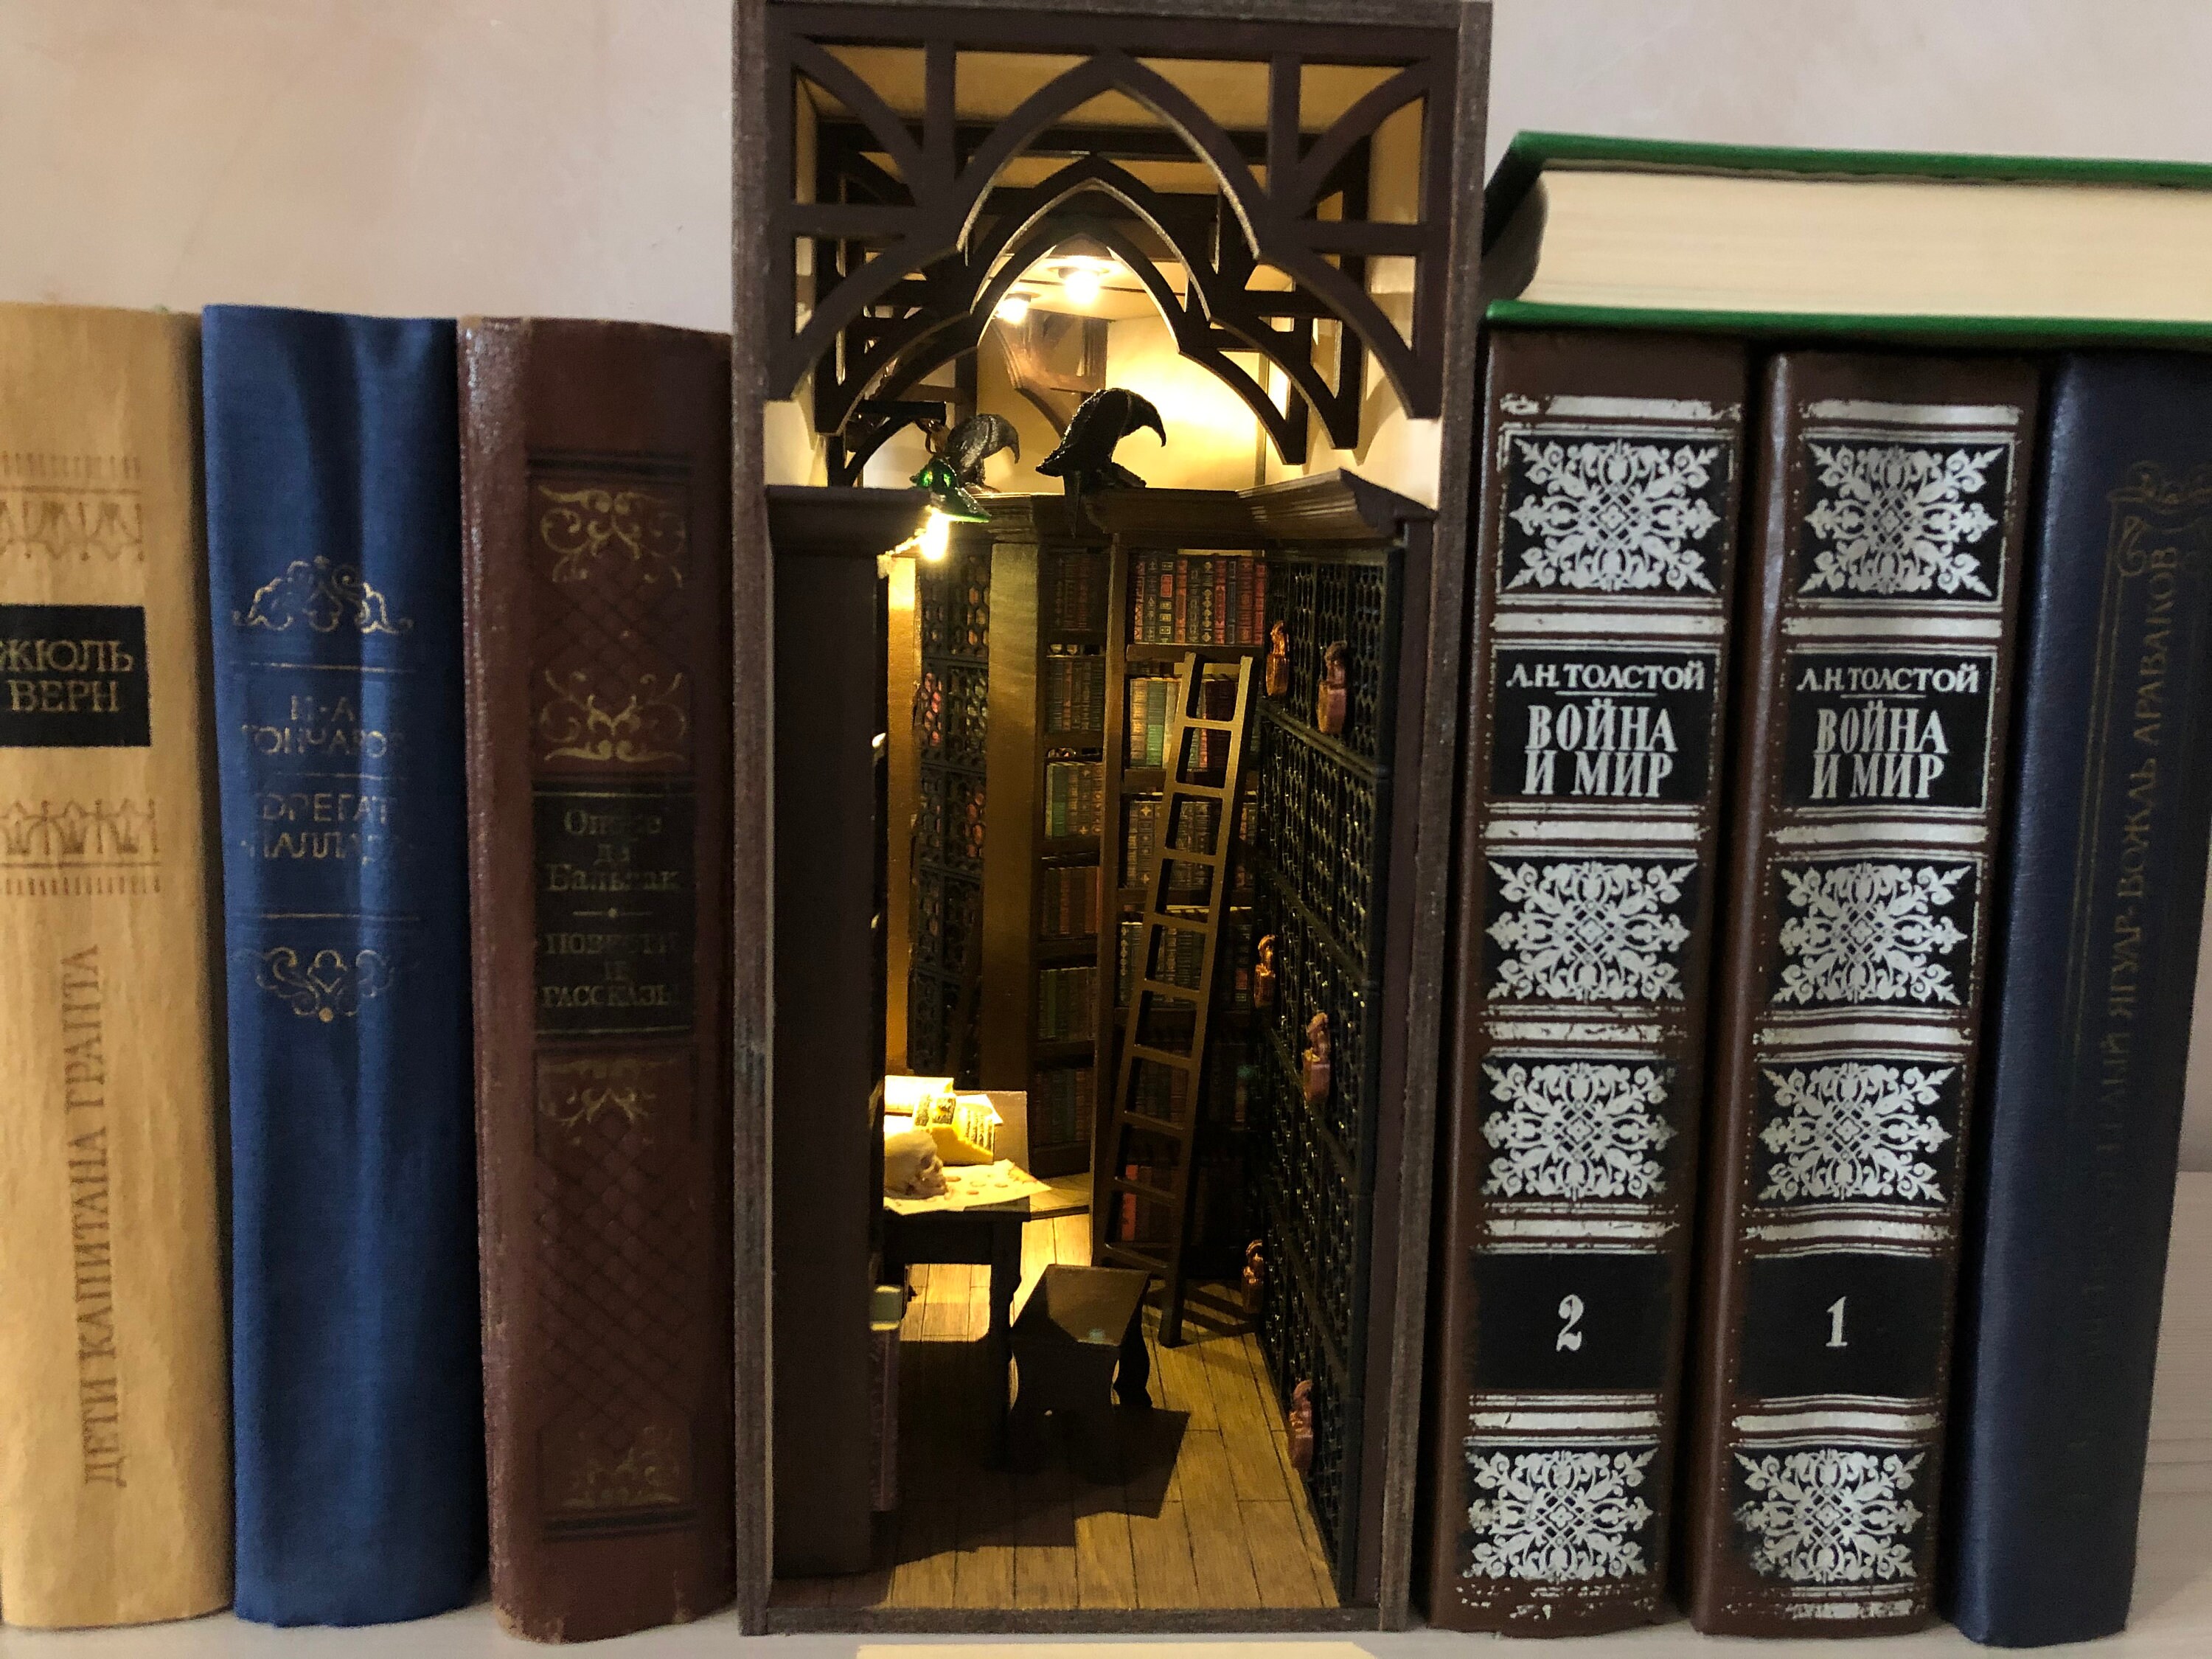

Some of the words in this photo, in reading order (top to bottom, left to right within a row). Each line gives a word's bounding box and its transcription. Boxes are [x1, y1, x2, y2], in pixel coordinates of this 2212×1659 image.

[0, 639, 134, 672] ЖЮЛЬ
[8, 679, 119, 712] ВЕРН
[1524, 698, 1680, 752] ВОЙНА
[1813, 700, 1950, 754] ВОЙНА
[1521, 750, 1557, 796] И
[1570, 751, 1674, 798] МИР
[1809, 754, 1841, 799] И
[1848, 754, 1945, 799] МИР
[60, 945, 105, 1115] ГРАНТА
[67, 1125, 117, 1362] КАПИТАНА
[1556, 1294, 1585, 1352] 2
[1825, 1296, 1848, 1347] 1
[79, 1376, 127, 1489] ДЕТИ
